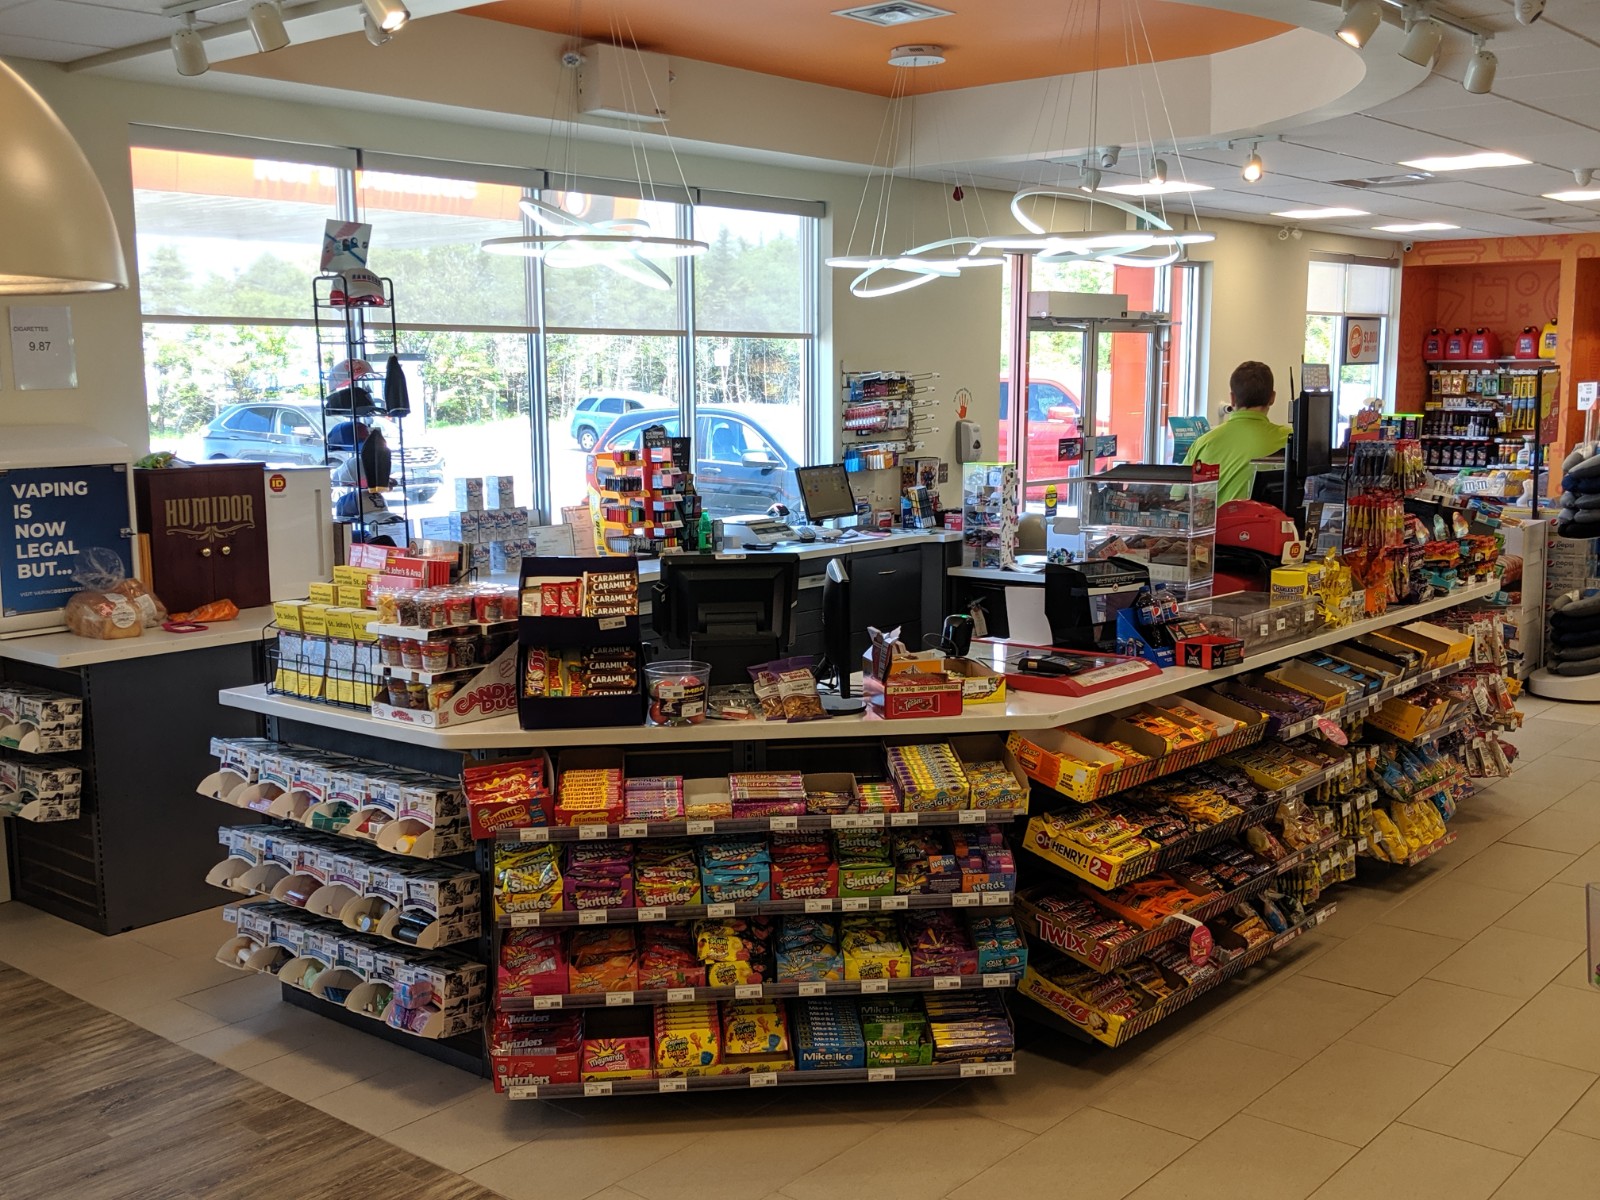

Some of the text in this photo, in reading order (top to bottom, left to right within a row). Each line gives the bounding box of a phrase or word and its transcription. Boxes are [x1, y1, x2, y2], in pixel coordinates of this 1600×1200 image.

[29, 341, 51, 351] 9.87
[11, 481, 88, 499] VAPING
[272, 480, 284, 488] ID
[13, 503, 32, 520] IS
[165, 494, 256, 529] HUMIDOR
[15, 521, 66, 539] NOW
[16, 540, 80, 560] LEGAL
[17, 561, 73, 579] BUT...
[592, 573, 631, 583] CARAMILK
[593, 580, 631, 591] CARAMILK
[593, 593, 633, 603] CARAMILK
[284, 613, 298, 621] John's
[592, 606, 632, 615] CARAMILK
[336, 621, 351, 629] John's
[592, 646, 631, 654] CARAMILK
[590, 661, 629, 670] CARAMILK
[591, 675, 631, 684] CARAMILK
[454, 683, 516, 716] CANDY
[1020, 744, 1040, 757] Reese
[480, 804, 526, 828] Starburst
[488, 820, 514, 832] minis
[773, 836, 824, 845] Skittles
[838, 837, 882, 848] Skittles
[1035, 833, 1089, 869] OH HENRY!
[643, 868, 693, 879] Skittles
[1090, 860, 1102, 876] 2
[846, 875, 890, 889] Skittles
[645, 891, 691, 906] Skittles
[713, 889, 759, 903] Skittles
[782, 886, 827, 899] Skittles
[505, 899, 551, 913] Skittles
[576, 895, 623, 910] Skittles
[861, 1006, 890, 1014] Mike
[508, 1014, 550, 1025] Twizzlers
[500, 1038, 543, 1051] Twizzlers
[803, 1052, 854, 1061] Mike Ike
[498, 1074, 551, 1087] Twizzlers
